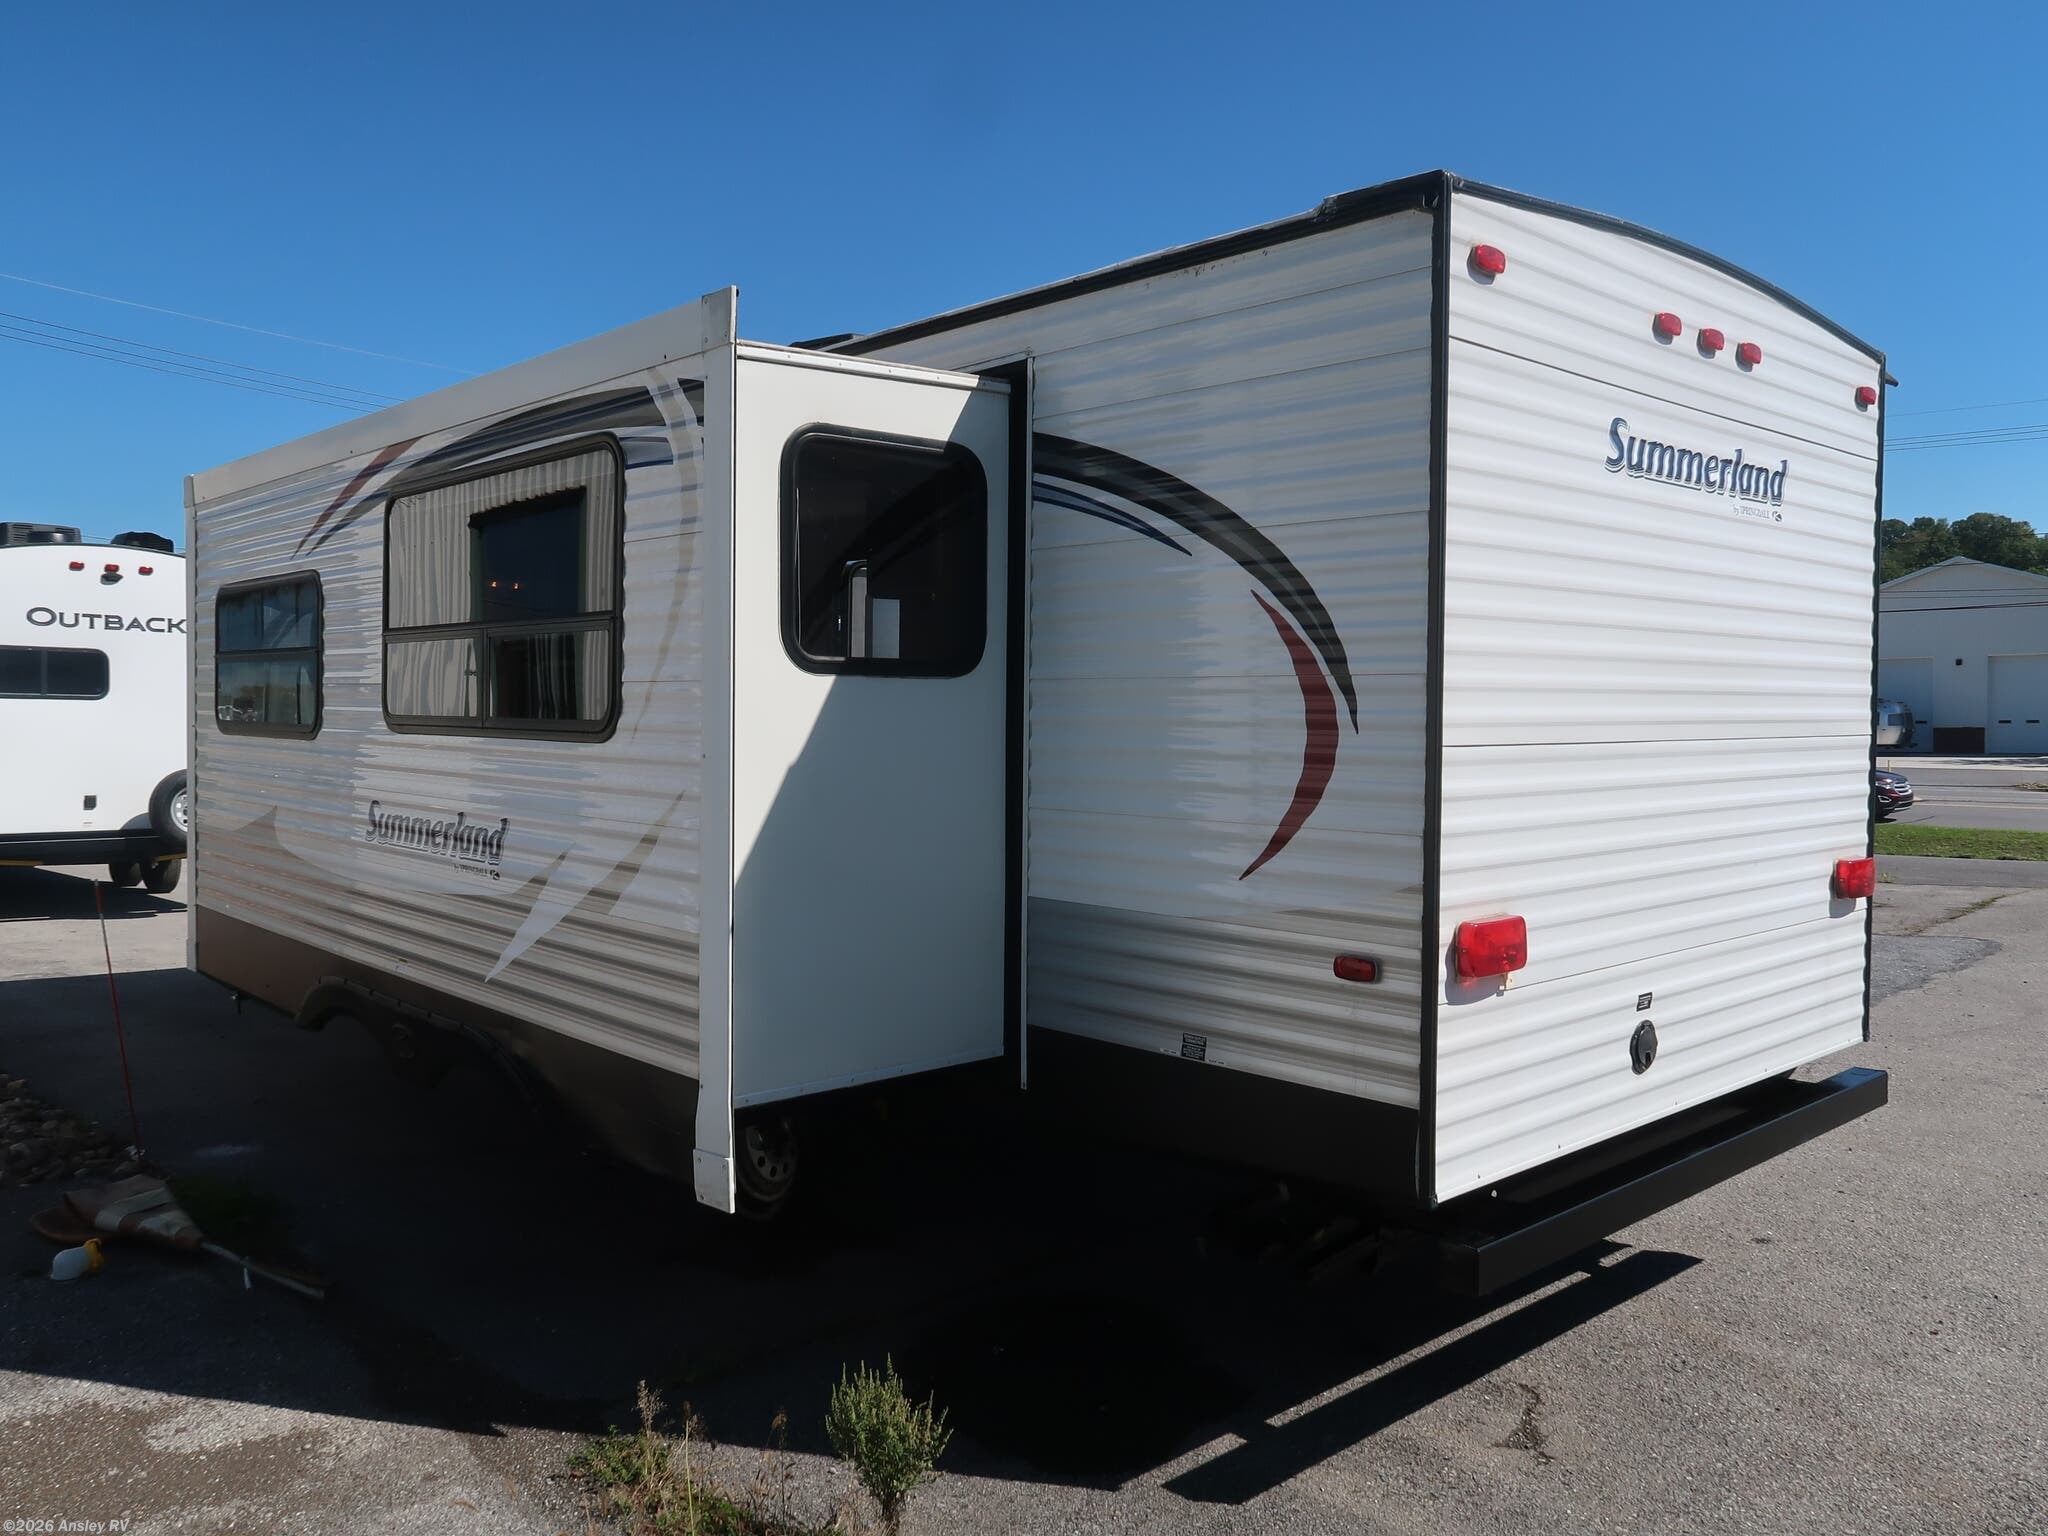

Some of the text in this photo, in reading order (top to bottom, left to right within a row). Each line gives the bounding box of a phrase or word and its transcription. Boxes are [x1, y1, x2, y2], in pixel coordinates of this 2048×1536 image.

[1605, 417, 1788, 506] Summerland
[26, 607, 187, 633] OUTBACK
[365, 800, 510, 865] Summerland
